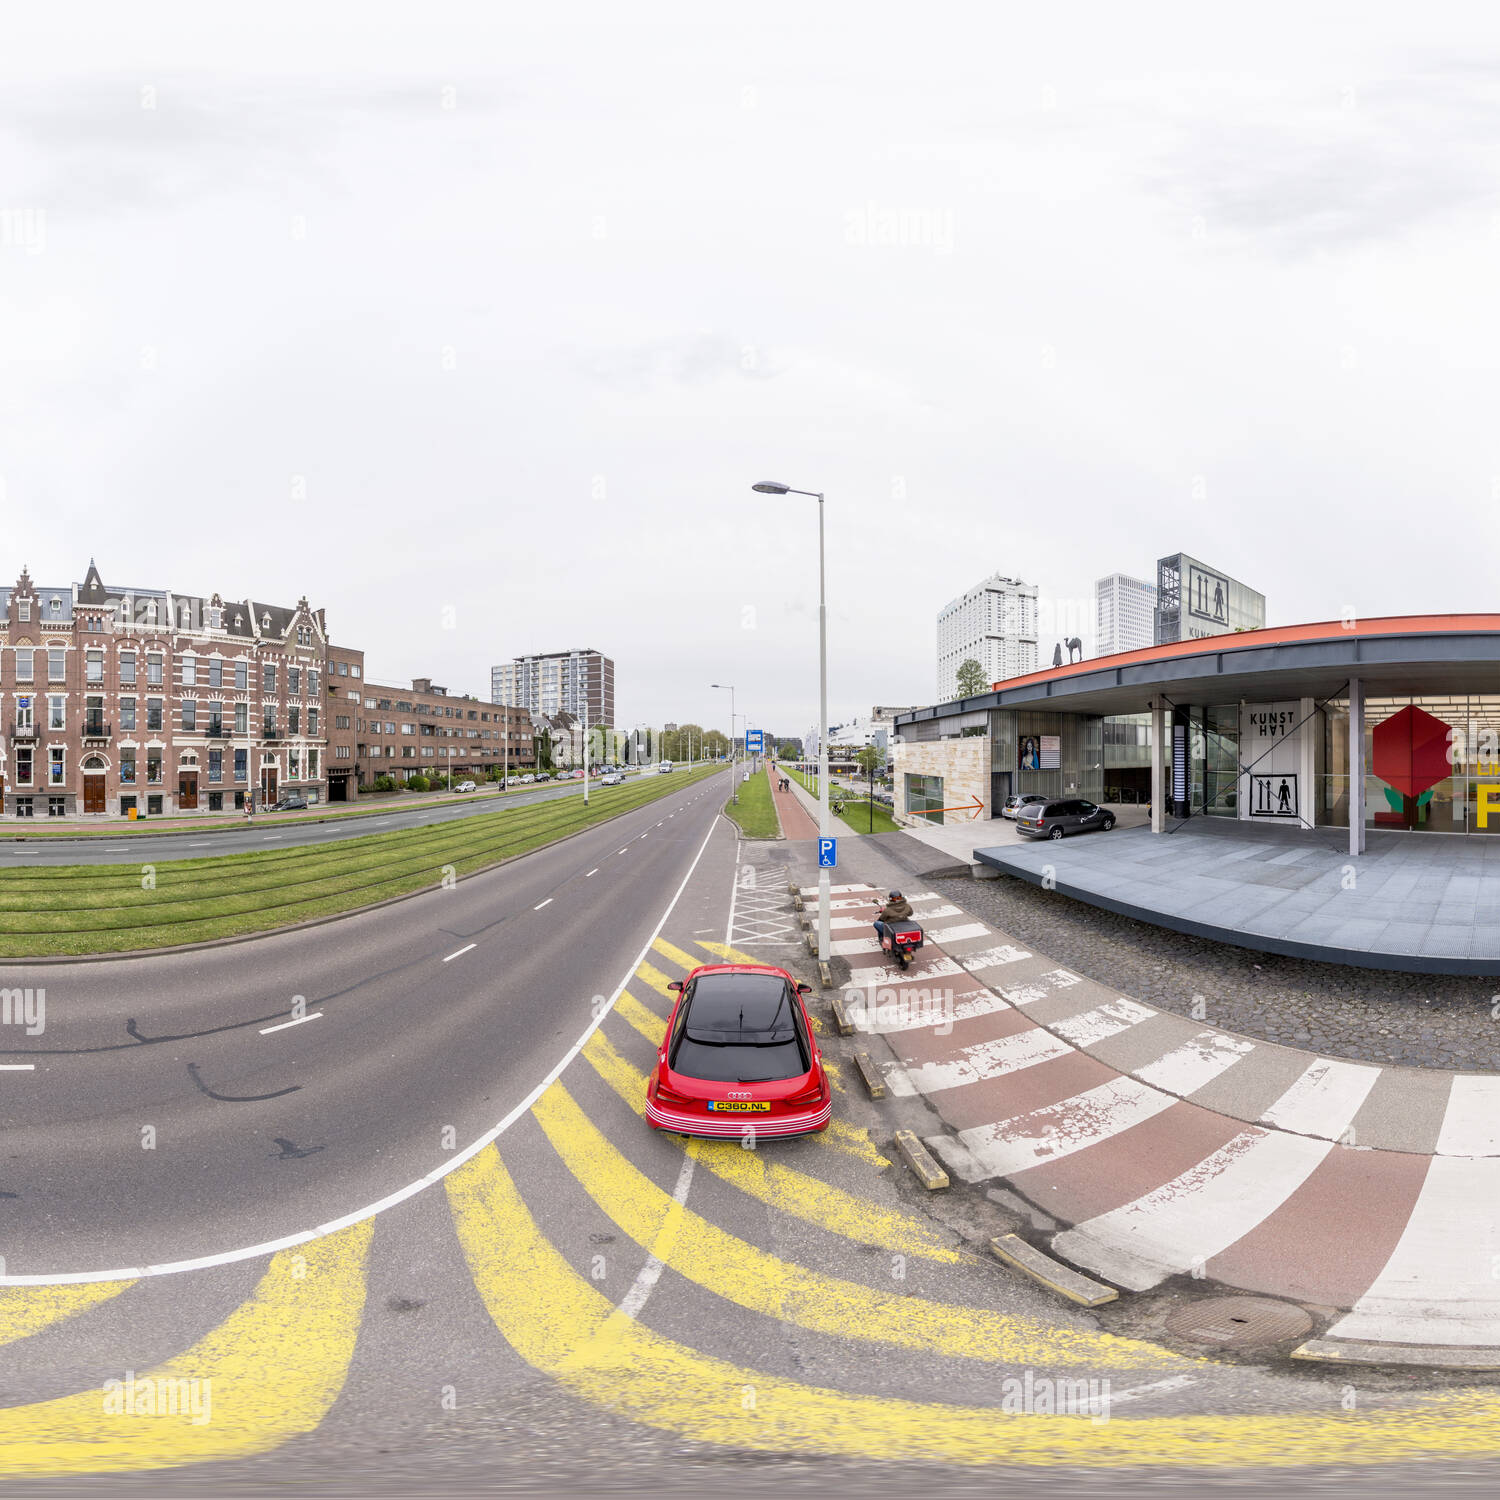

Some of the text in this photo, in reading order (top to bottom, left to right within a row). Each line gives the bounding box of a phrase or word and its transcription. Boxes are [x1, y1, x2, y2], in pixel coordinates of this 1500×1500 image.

[1189, 627, 1214, 639] KUN
[1250, 712, 1294, 724] KUNST
[821, 840, 833, 855] P
[716, 1102, 767, 1110] C360.NL
